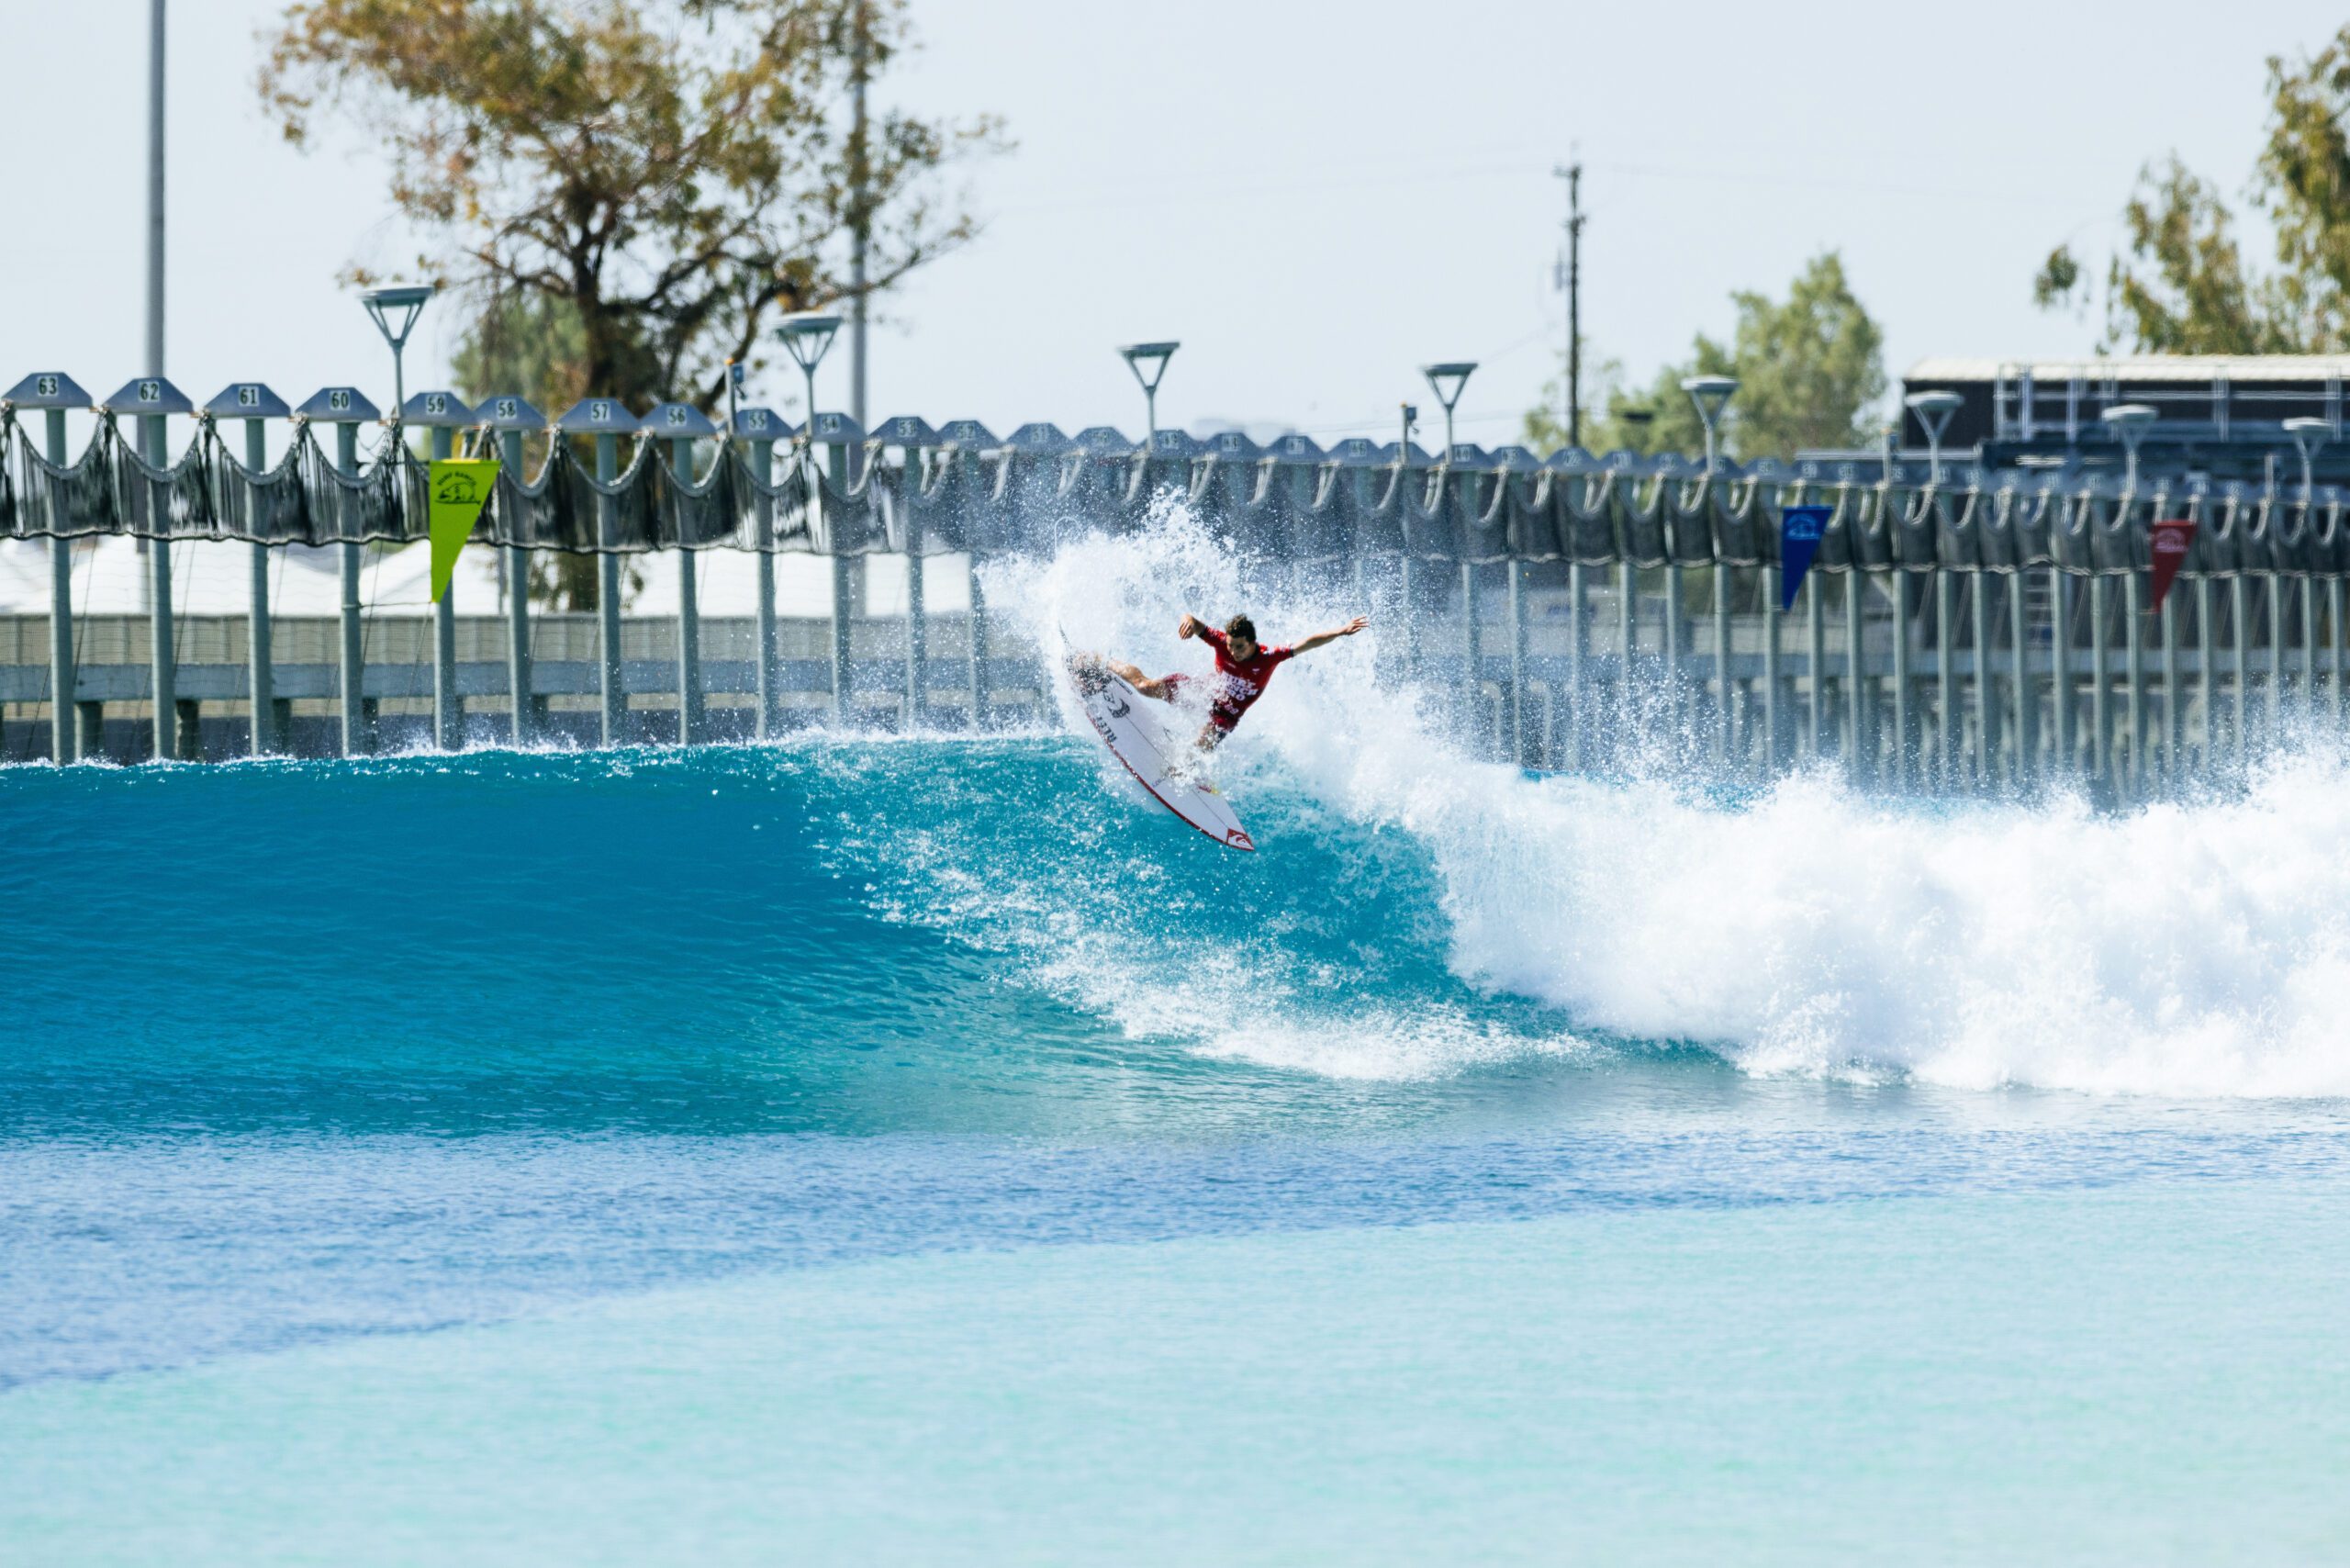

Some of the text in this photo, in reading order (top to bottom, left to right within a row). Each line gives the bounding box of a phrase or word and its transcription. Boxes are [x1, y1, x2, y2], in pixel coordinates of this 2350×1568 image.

[39, 377, 57, 396] 63
[140, 383, 159, 400] 62
[240, 388, 257, 406] 61
[331, 392, 350, 409] 60
[428, 397, 444, 413] 59
[498, 401, 516, 417] 58
[592, 403, 608, 420] 57
[668, 408, 686, 423] 56
[748, 411, 766, 428] 55
